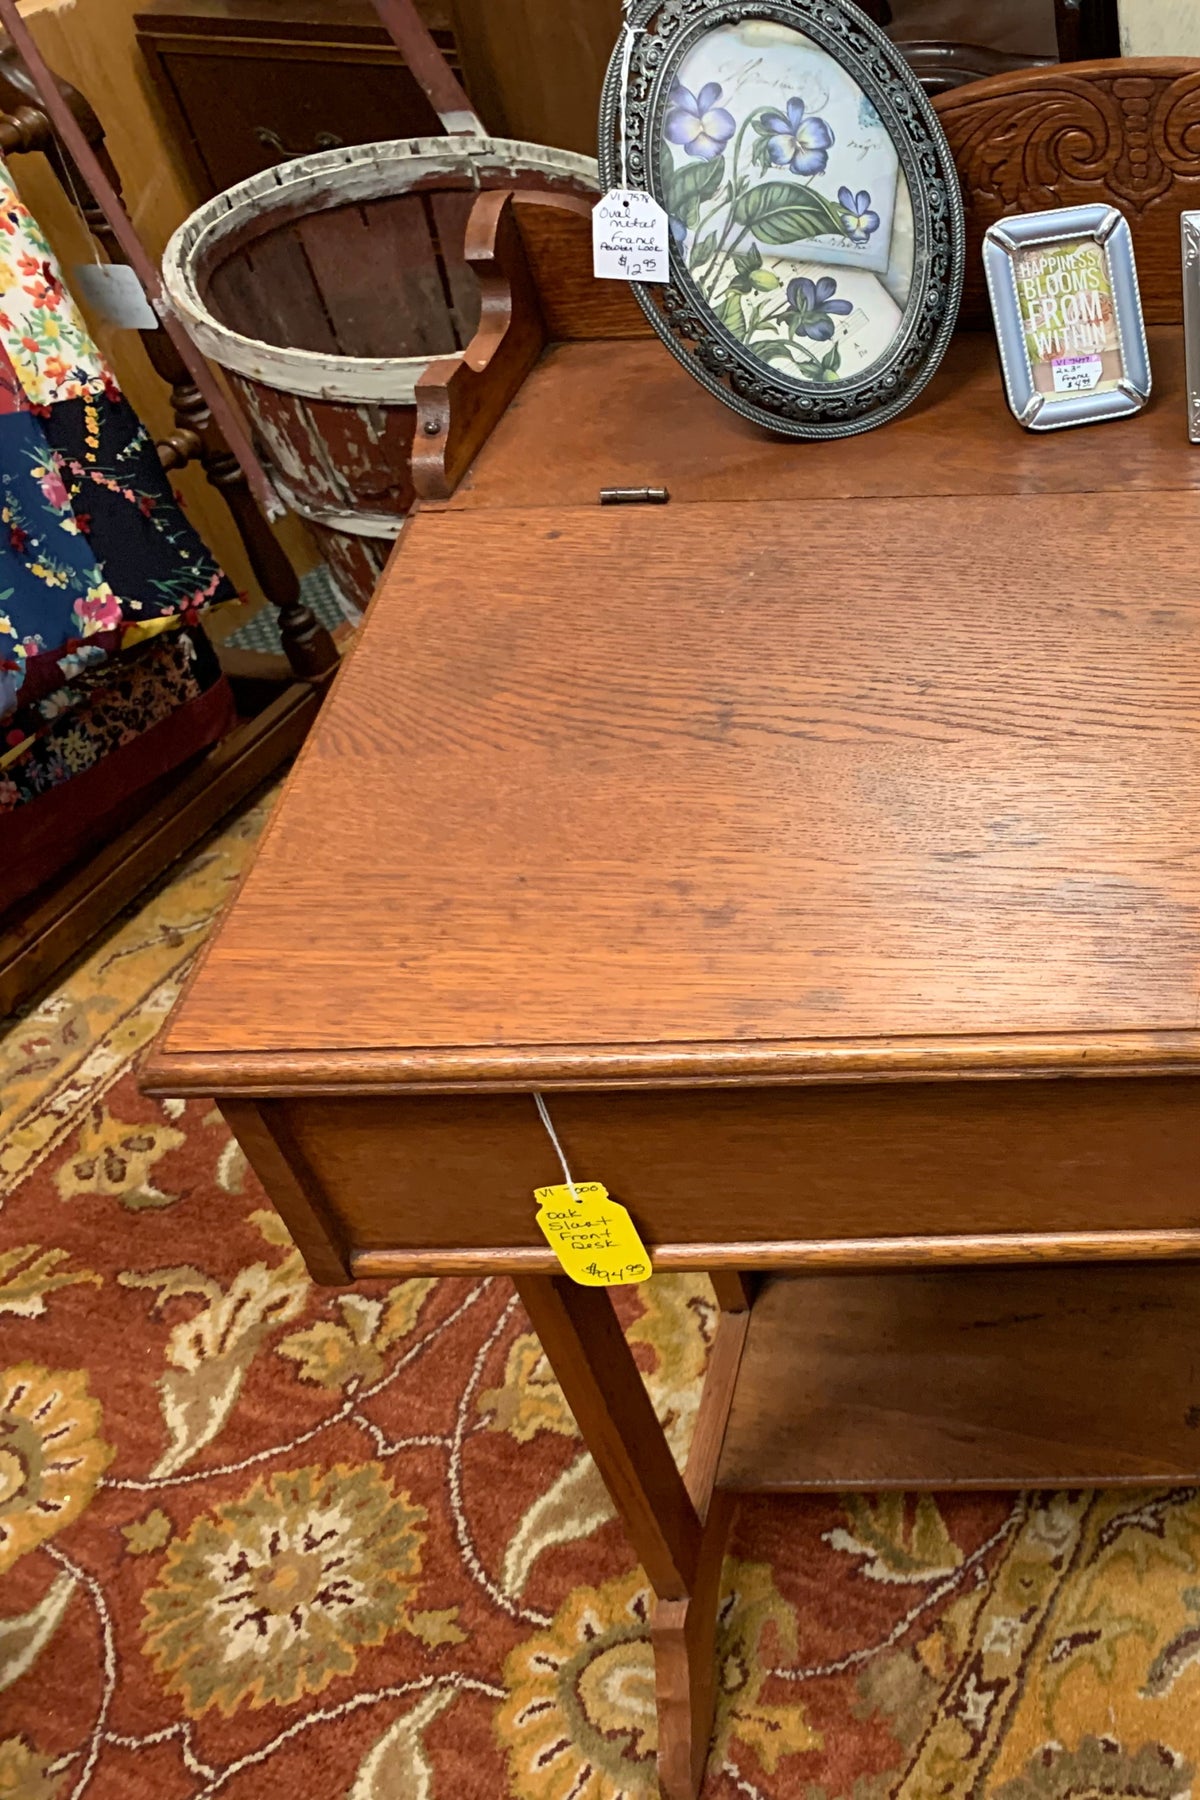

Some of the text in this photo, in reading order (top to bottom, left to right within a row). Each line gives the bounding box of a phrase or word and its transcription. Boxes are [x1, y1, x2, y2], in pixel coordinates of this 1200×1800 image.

[599, 207, 631, 219] Oval
[1019, 250, 1097, 278] HAPPINESS
[1023, 267, 1100, 300] BLOOMS
[1027, 290, 1103, 332] FROM
[1032, 320, 1107, 358] WITHIN
[546, 1209, 582, 1220] Oak
[560, 1229, 612, 1240] Front
[571, 1240, 622, 1249] Desk
